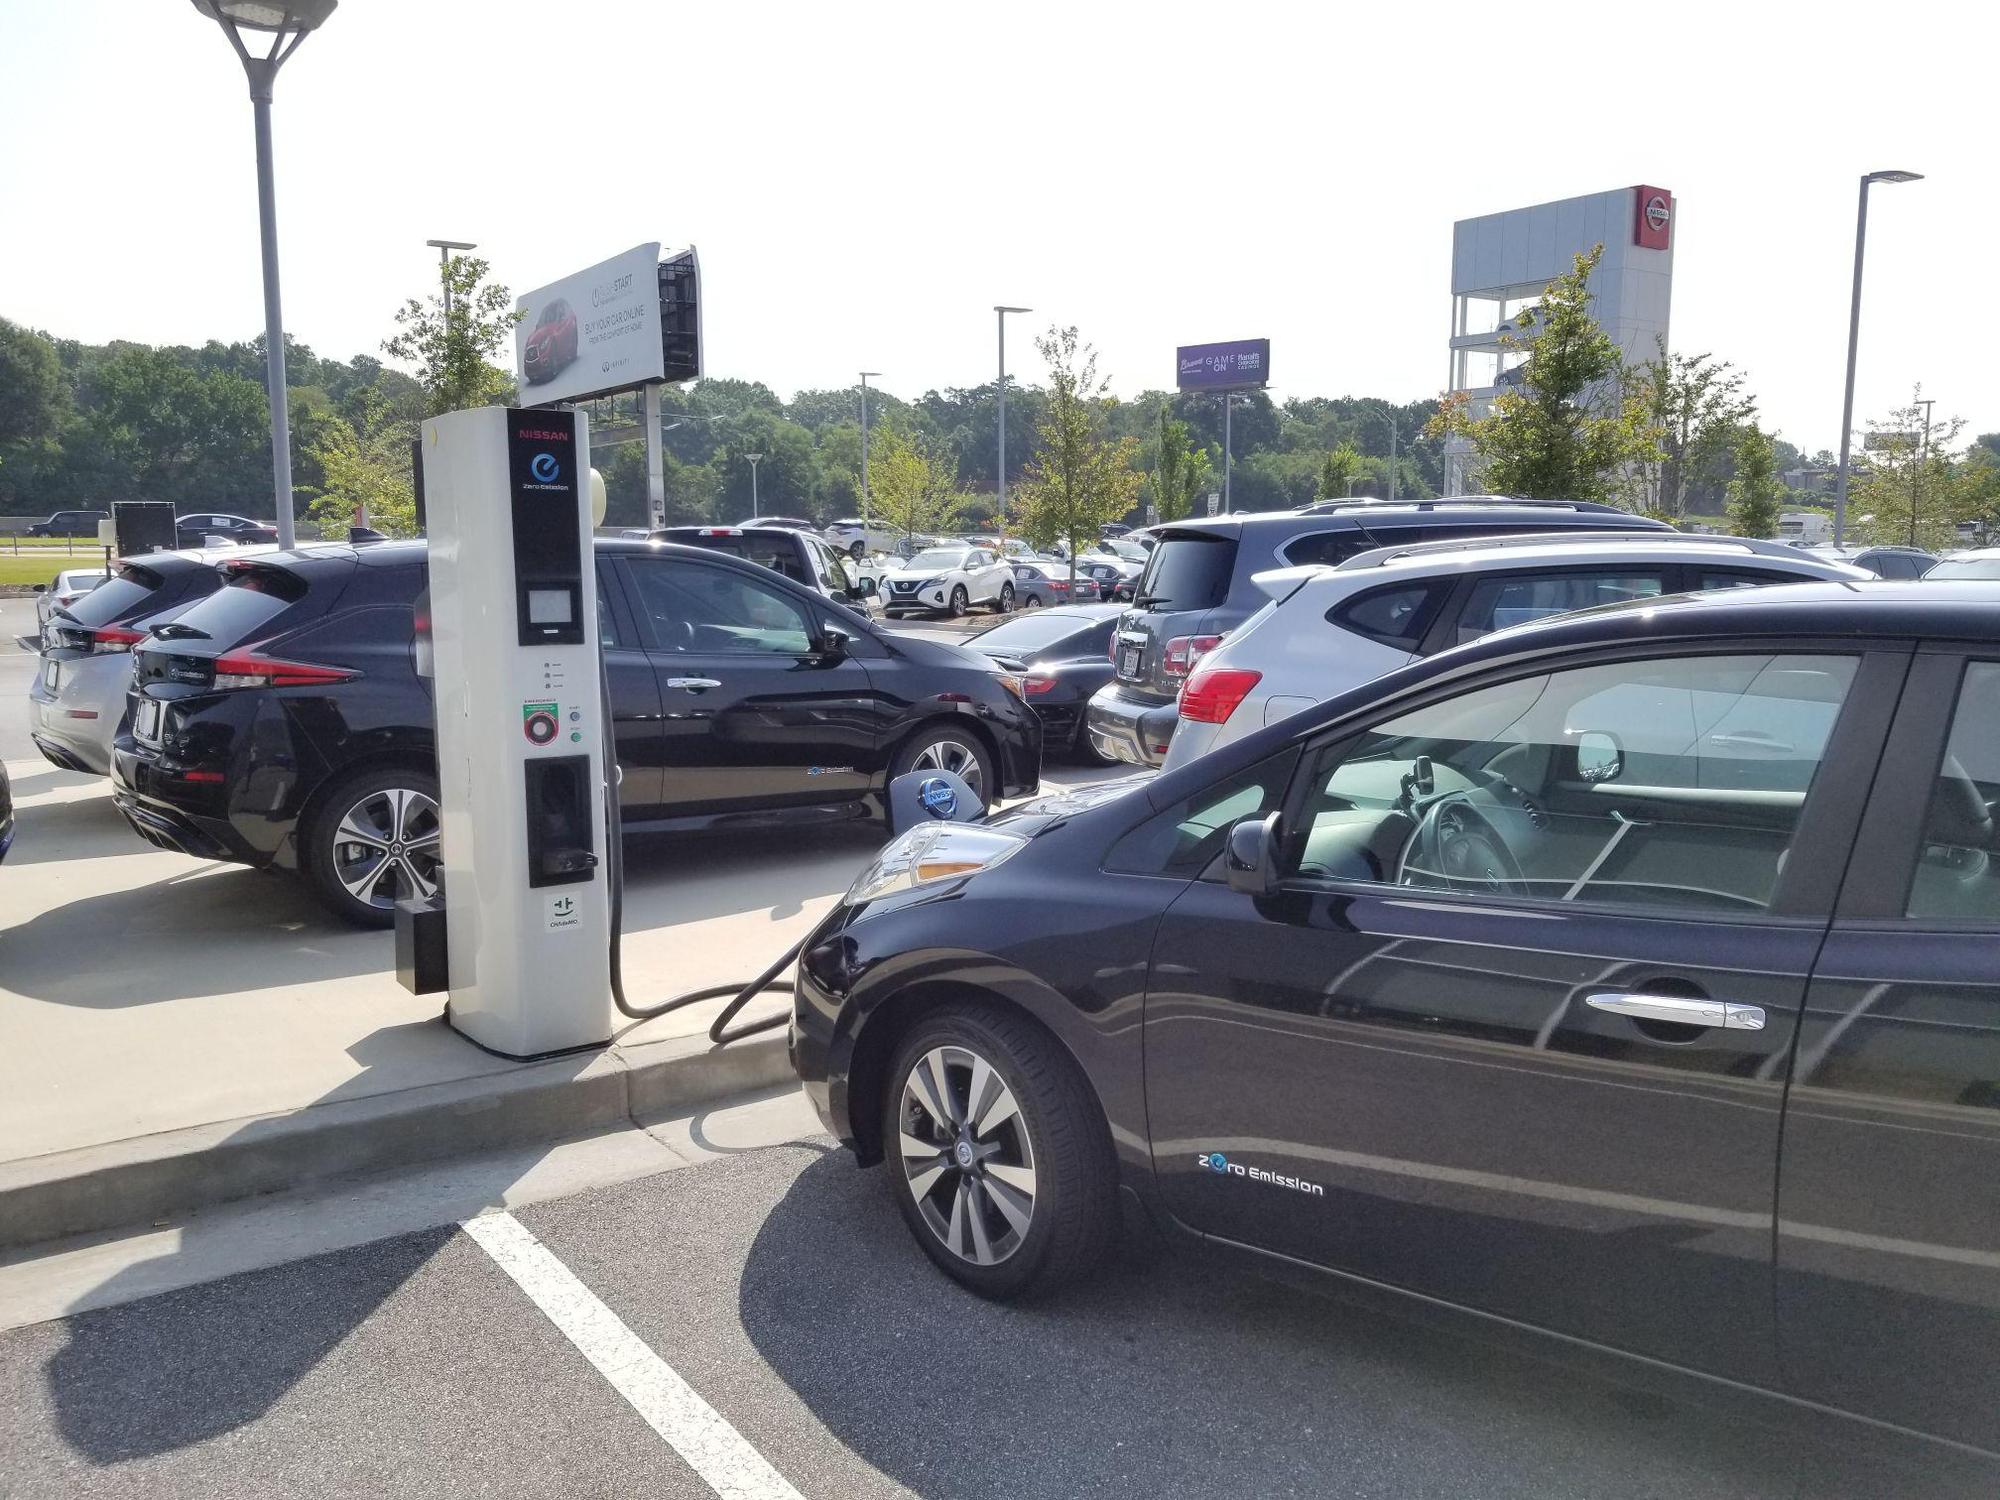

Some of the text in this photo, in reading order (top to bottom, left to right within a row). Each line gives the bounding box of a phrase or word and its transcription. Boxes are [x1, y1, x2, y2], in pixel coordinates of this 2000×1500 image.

[1205, 354, 1235, 365] GAME
[1213, 364, 1226, 372] ON
[519, 429, 568, 440] NISSAN
[1248, 1166, 1324, 1196] Emission
